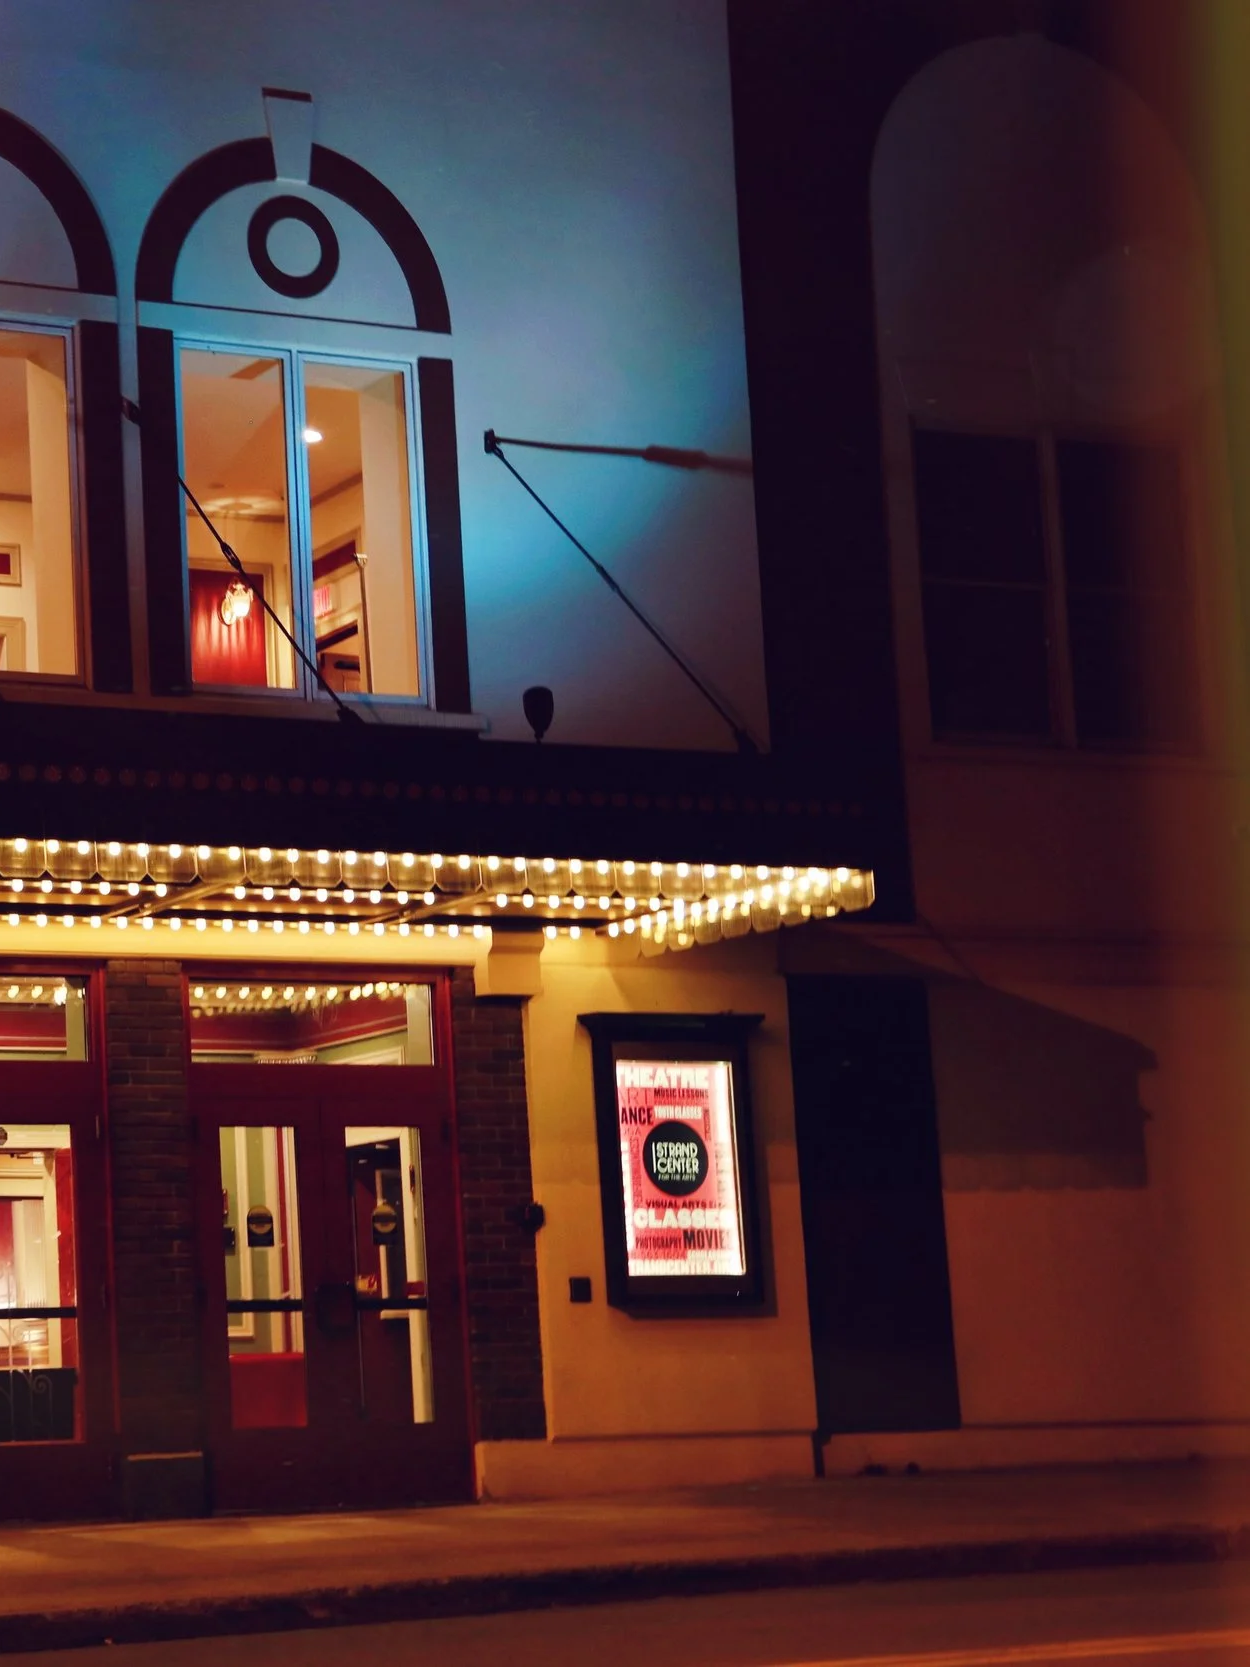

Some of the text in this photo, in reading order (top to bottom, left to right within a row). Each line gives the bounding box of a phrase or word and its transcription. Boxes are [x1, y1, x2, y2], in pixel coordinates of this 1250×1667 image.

[616, 1066, 710, 1089] THEATRE
[653, 1088, 677, 1099] MUSIC
[656, 1141, 699, 1158] STRAND
[657, 1157, 700, 1174] CENTER
[645, 1200, 680, 1209] VISUAL
[681, 1200, 707, 1209] ARTS
[635, 1236, 682, 1249] PHOTOGRAPHY
